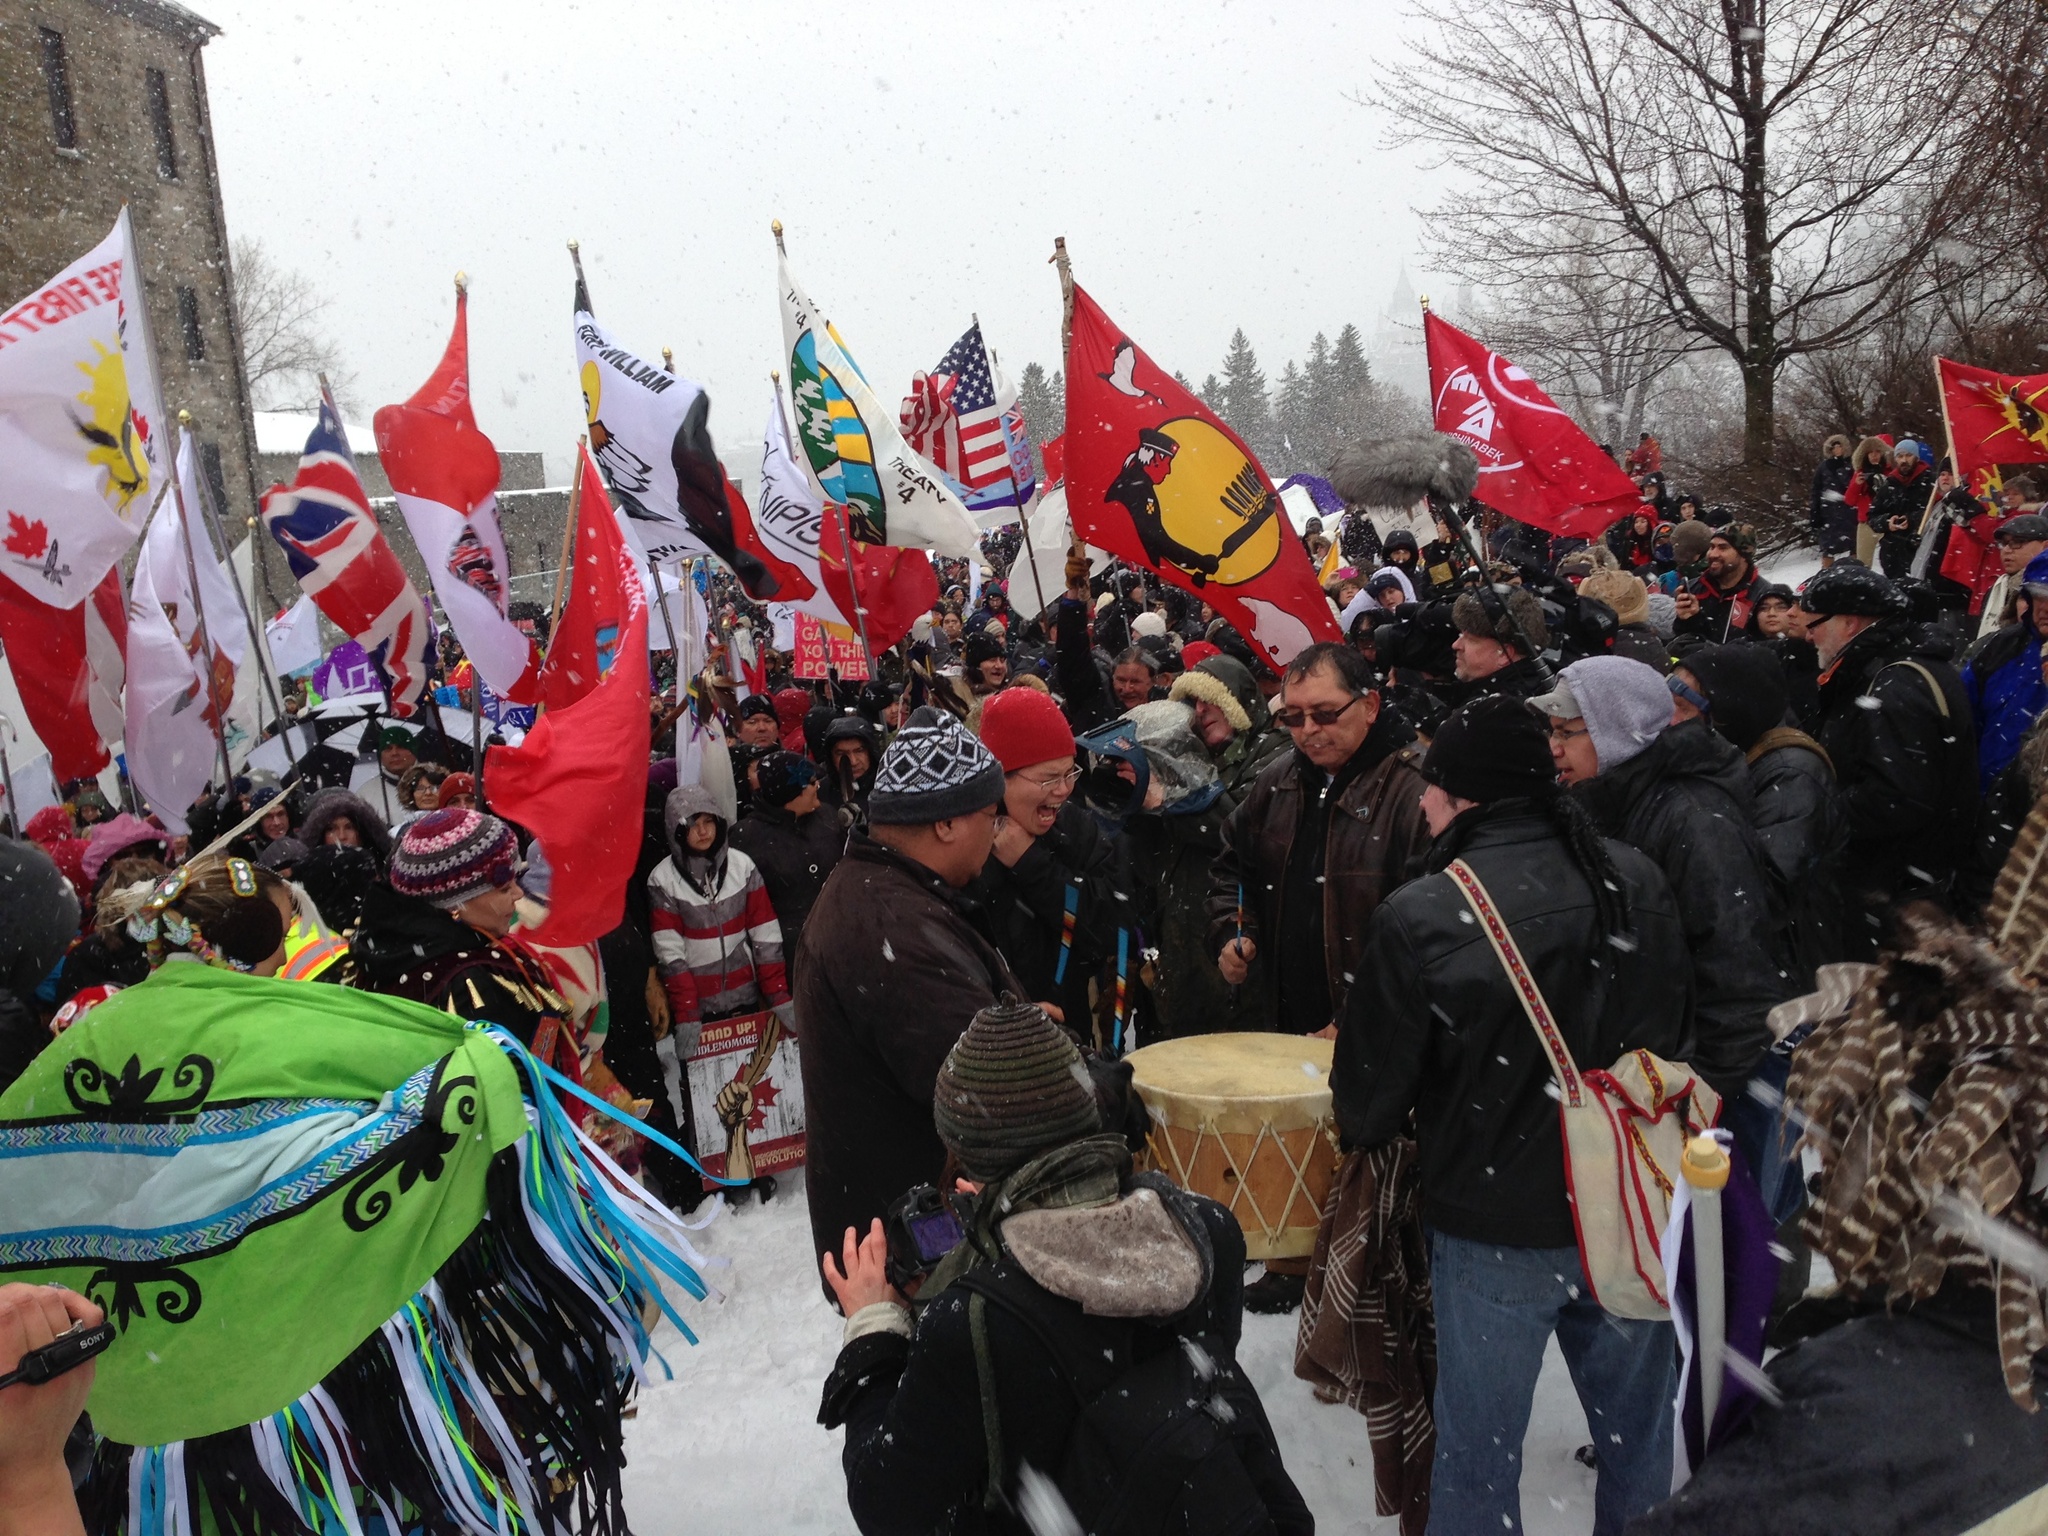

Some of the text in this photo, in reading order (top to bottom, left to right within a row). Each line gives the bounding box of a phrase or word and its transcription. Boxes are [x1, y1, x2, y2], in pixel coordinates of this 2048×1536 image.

[598, 348, 675, 395] WILLIAM
[888, 456, 947, 504] TREATY
[802, 626, 842, 641] GAV
[803, 660, 869, 678] POWER
[700, 1020, 757, 1044] TAND UP!
[80, 1332, 105, 1349] SONY
